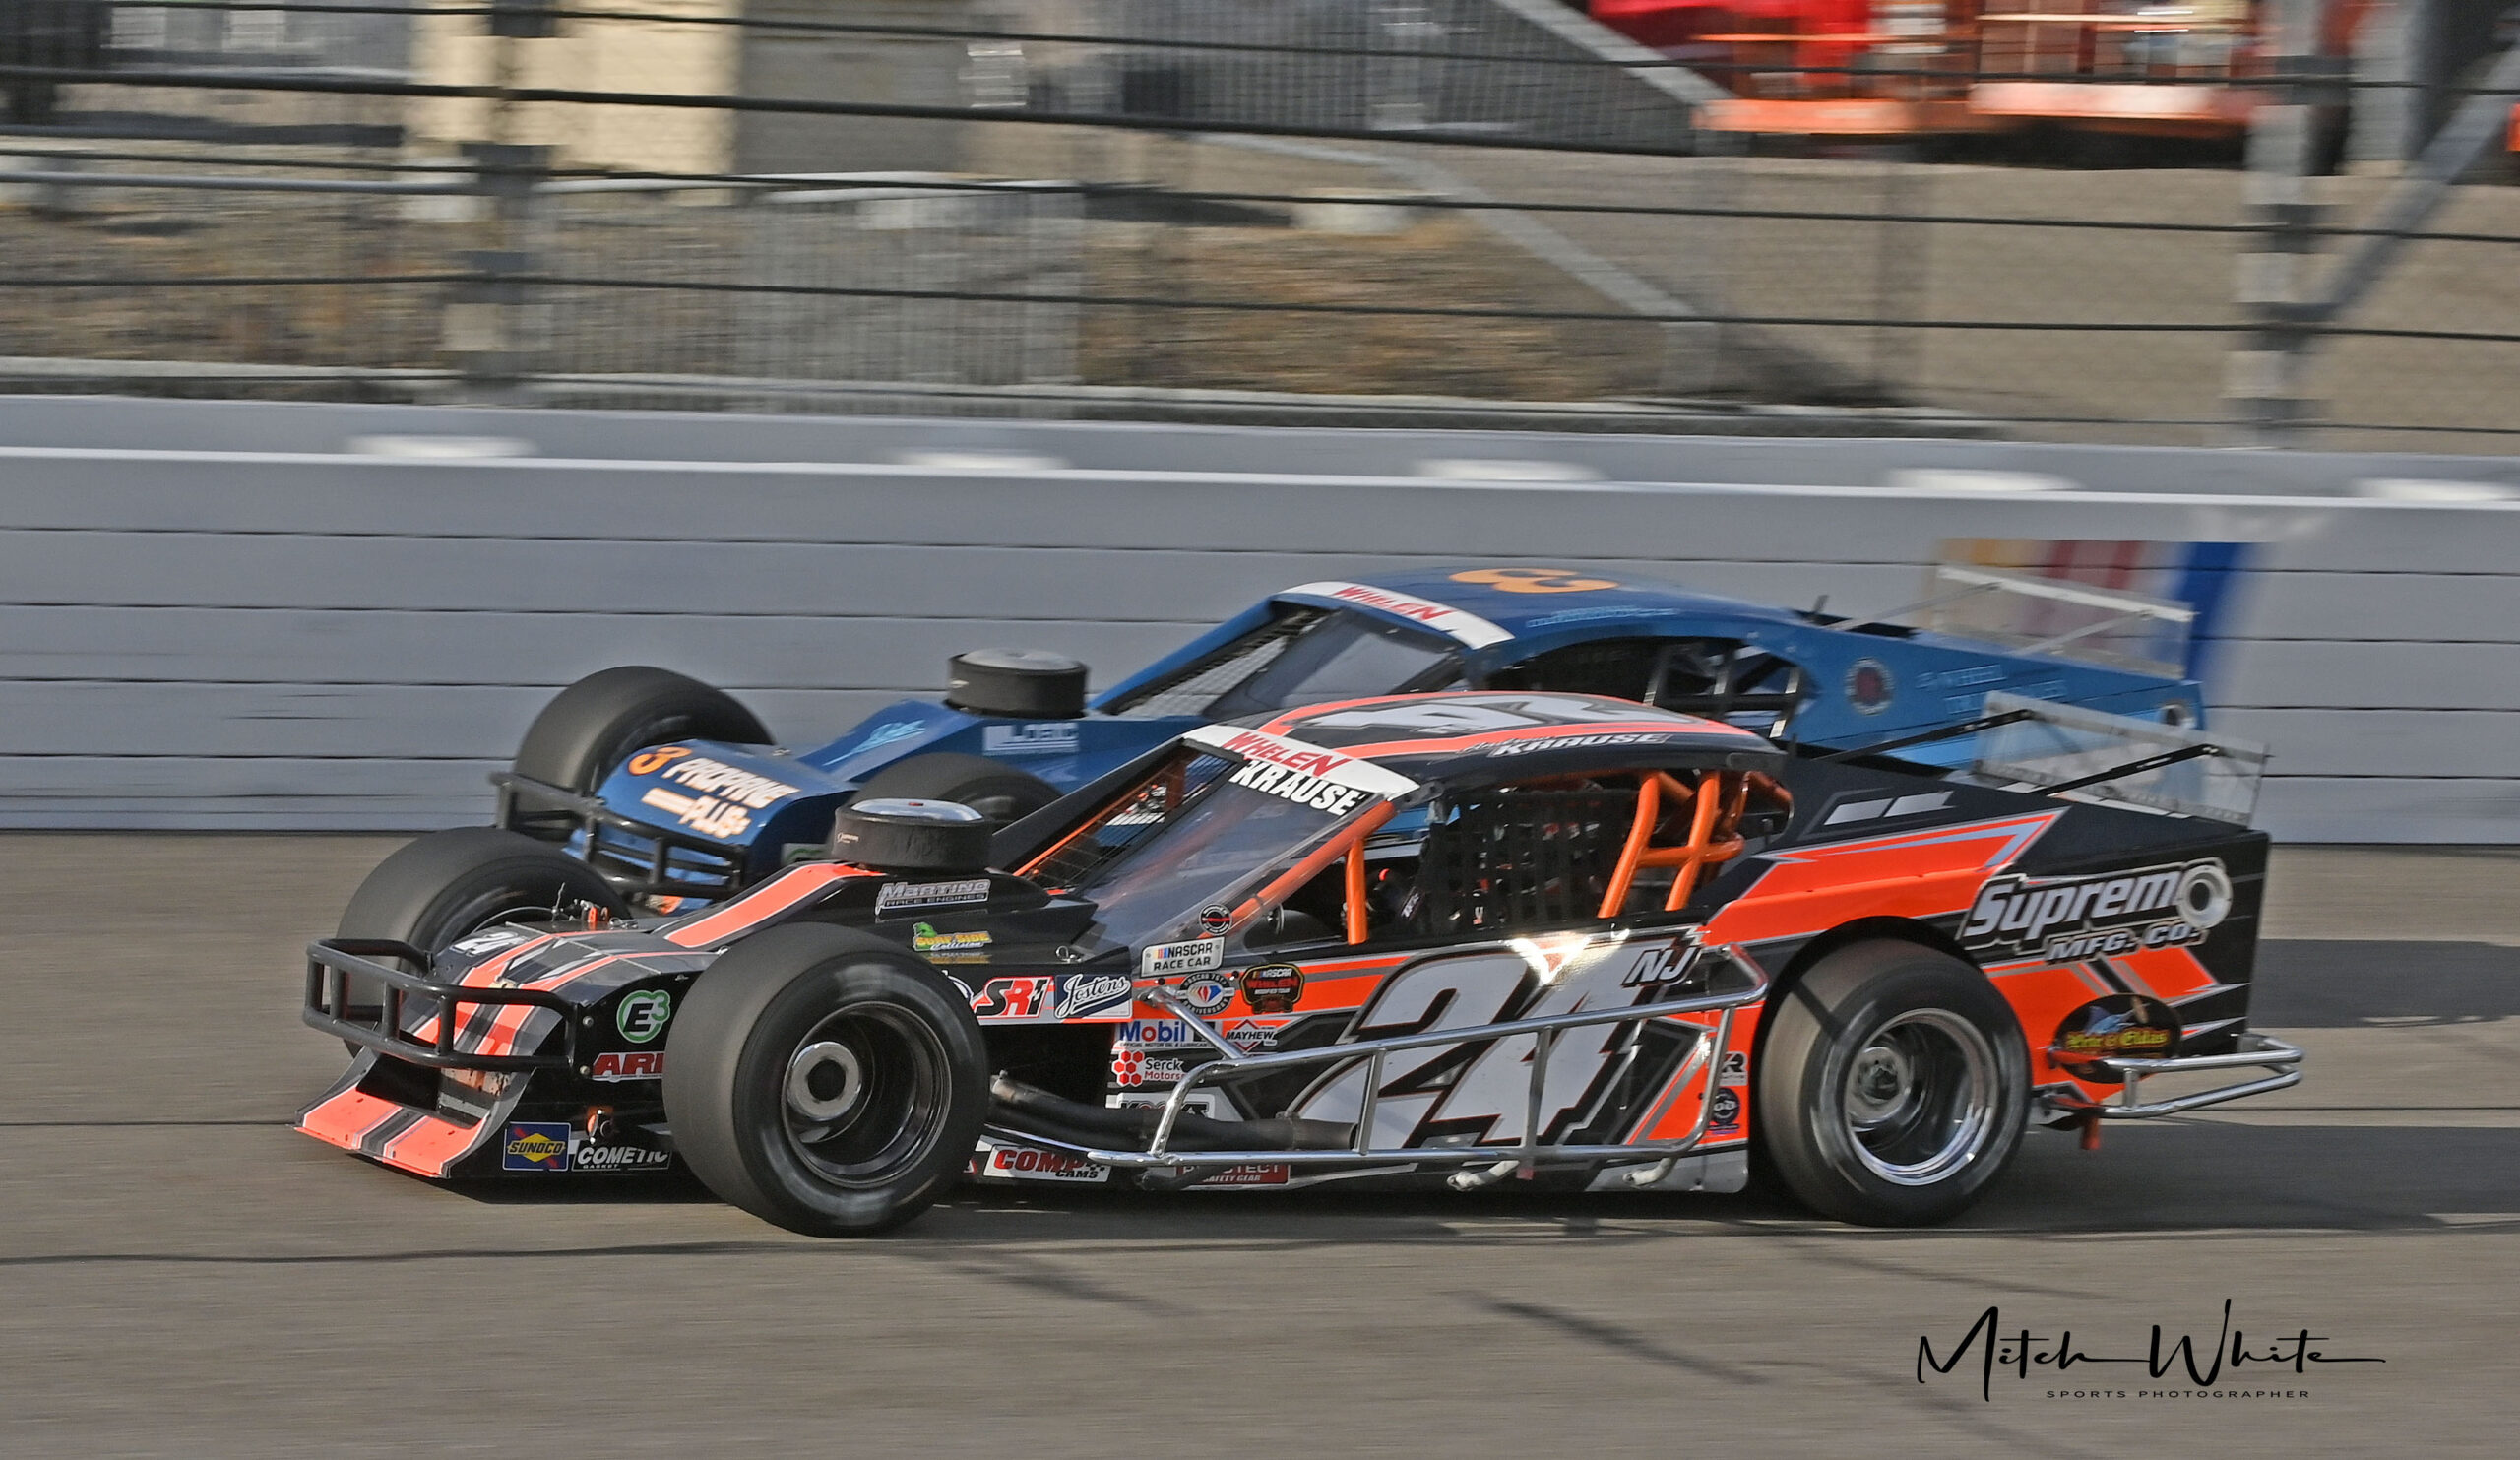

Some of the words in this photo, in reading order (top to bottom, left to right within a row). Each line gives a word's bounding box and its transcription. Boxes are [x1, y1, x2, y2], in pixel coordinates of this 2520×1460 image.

[1222, 731, 1352, 777] WHELEN
[1490, 734, 1670, 757] KRAUSE
[628, 746, 693, 775] 3
[661, 758, 801, 809] PROPANE
[1228, 760, 1358, 816] KRAUSE
[926, 893, 985, 904] ENGINES
[1168, 942, 1213, 958] NASCAR
[1154, 960, 1186, 972] RACE
[1188, 956, 1212, 966] CAR
[1626, 948, 1698, 984] NJ
[1056, 975, 1128, 1018] Jostens
[1120, 1020, 1185, 1042] Mobil
[1225, 1031, 1276, 1041] MAYHEW
[1292, 942, 1678, 1149] 24
[1145, 1058, 1182, 1070] Serck
[509, 1141, 565, 1154] SUNOCO
[1055, 1169, 1099, 1179] CAMS
